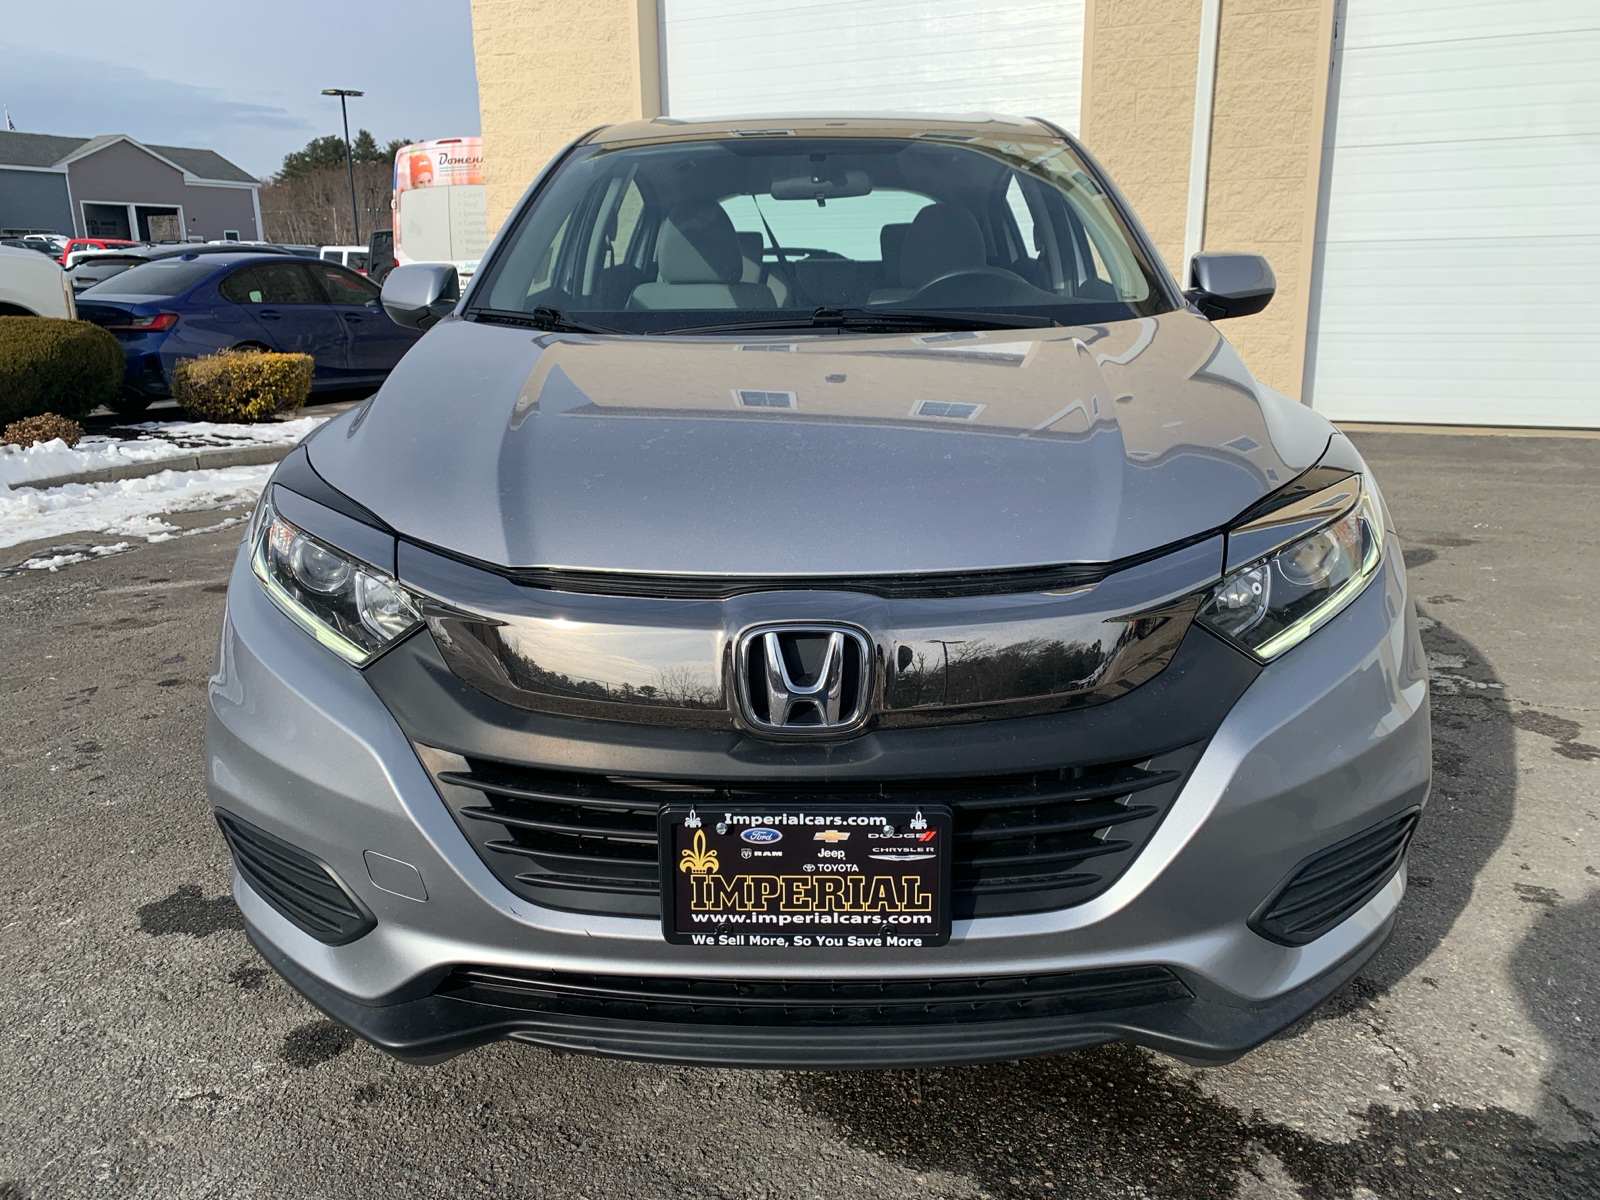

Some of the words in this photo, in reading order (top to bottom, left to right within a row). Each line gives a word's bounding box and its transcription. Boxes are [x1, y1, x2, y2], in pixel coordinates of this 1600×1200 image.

[724, 813, 887, 827] Imperialcars.com
[750, 830, 773, 841] Ford
[817, 848, 846, 860] Jeep
[817, 863, 860, 872] TOYOTA
[690, 874, 932, 912] IMPERIAL
[691, 912, 932, 926] www.imperialcars.com
[691, 934, 715, 945] We
[718, 934, 745, 946] Sell
[749, 935, 790, 948] More,
[793, 935, 812, 947] So
[815, 935, 843, 947] You
[847, 935, 882, 947] Save
[886, 936, 922, 947] More
